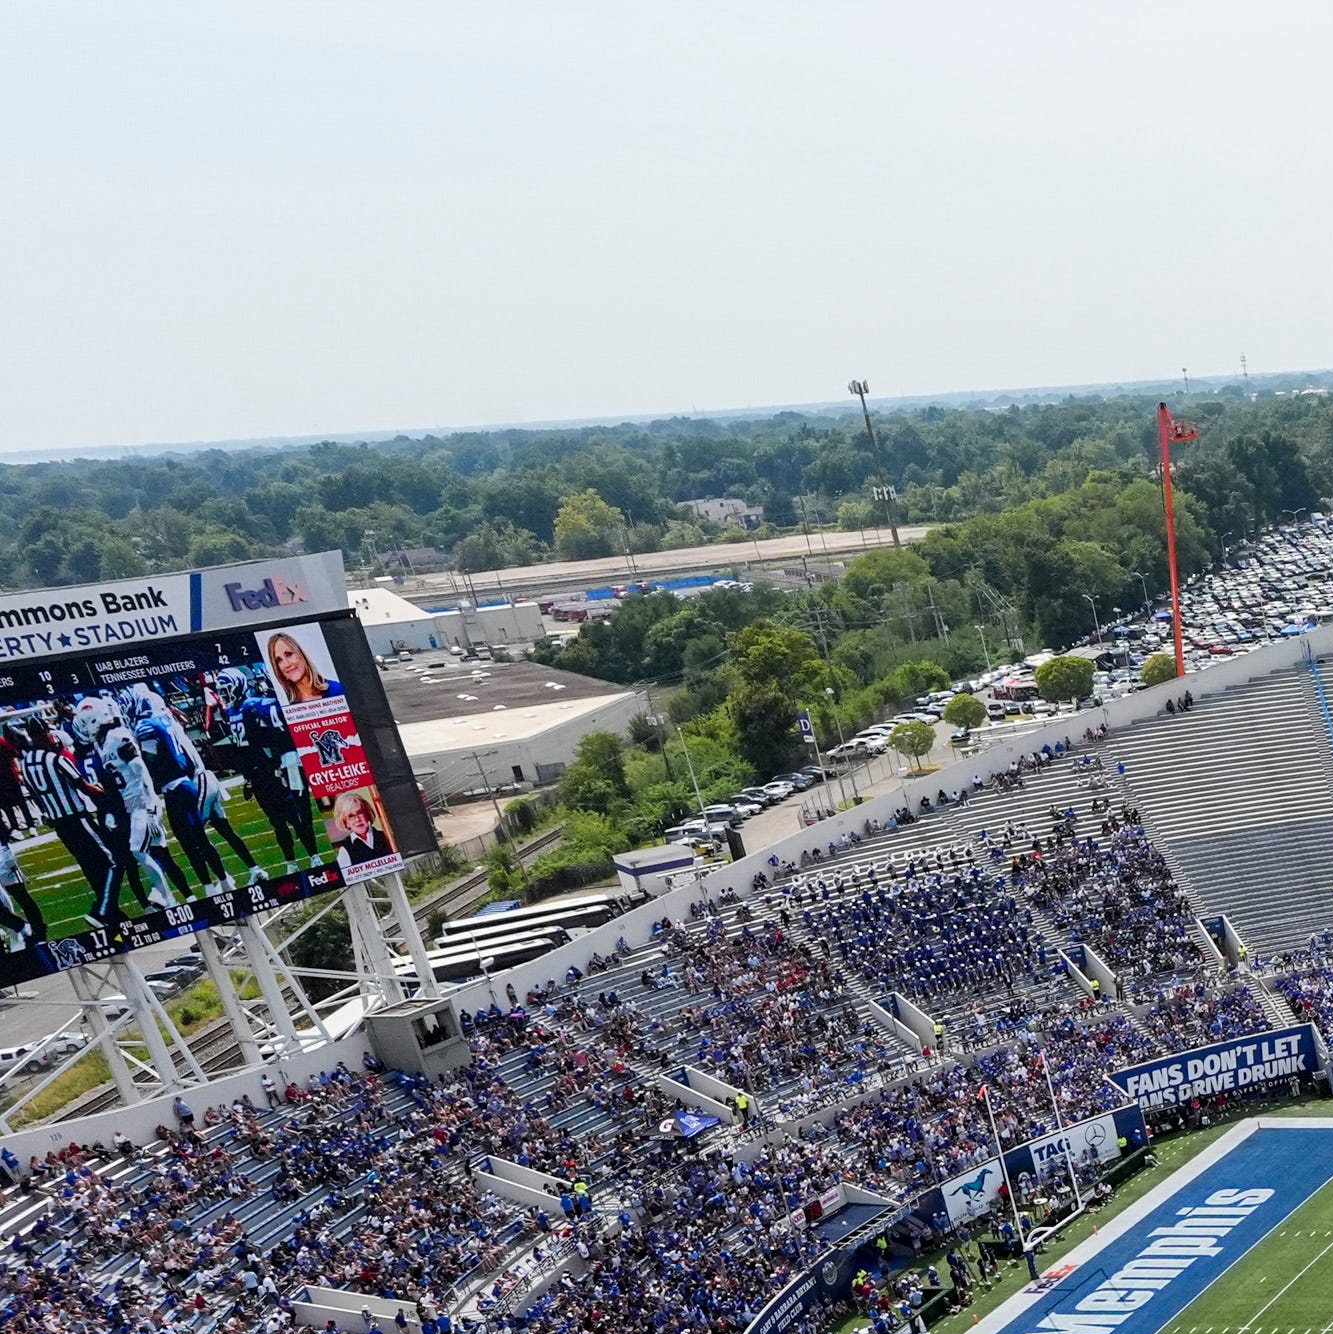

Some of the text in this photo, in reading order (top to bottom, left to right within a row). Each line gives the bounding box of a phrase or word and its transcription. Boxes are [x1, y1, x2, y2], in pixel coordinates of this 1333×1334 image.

[100, 586, 168, 615] Bank
[224, 577, 309, 612] FedEx
[73, 614, 178, 646] STADIUM
[241, 646, 249, 656] 2
[95, 655, 231, 674] UAB BLAZERS 42
[100, 660, 196, 684] TENNESSEE VOLUNTEERS
[38, 670, 80, 685] 10 3
[46, 683, 55, 695] 3
[293, 721, 321, 733] OFFICIAL
[347, 865, 365, 877] JUDY
[248, 885, 265, 904] 28
[165, 904, 195, 926] 8:00
[220, 902, 235, 919] 37
[90, 929, 109, 949] 17
[131, 934, 145, 948] 21
[1126, 1034, 1302, 1097] FANS DON'T LET
[1138, 1055, 1307, 1111] ANS DRIVE DRUNK
[660, 1119, 676, 1133] G
[1033, 1138, 1072, 1161] TAG
[774, 1294, 798, 1322] BARBARA
[796, 1277, 818, 1300] BRYANT
[777, 1302, 803, 1333] FIELD CLUB
